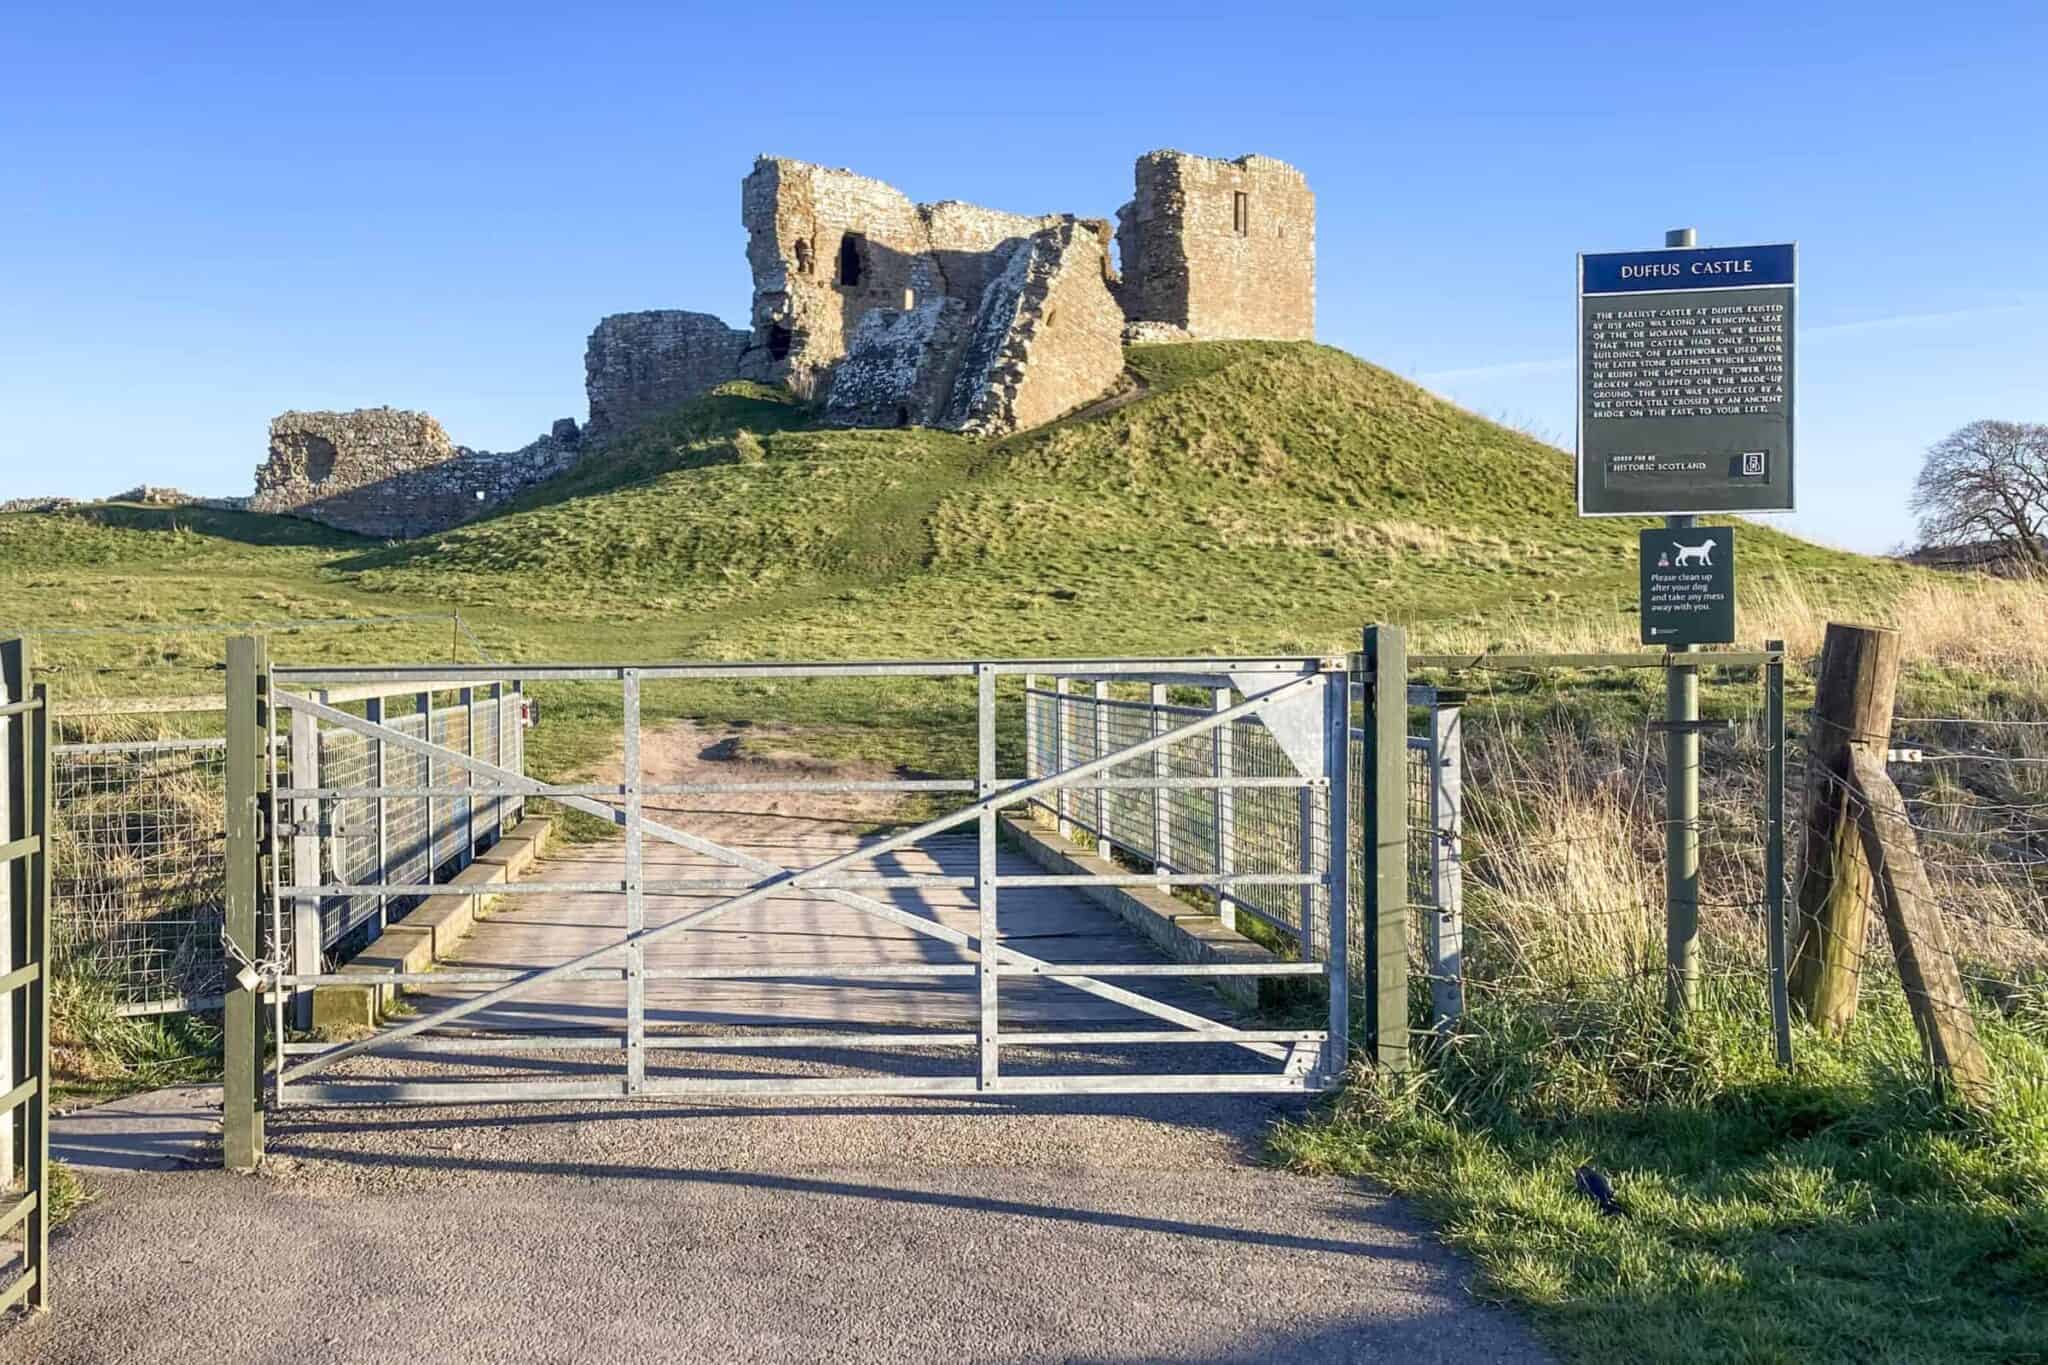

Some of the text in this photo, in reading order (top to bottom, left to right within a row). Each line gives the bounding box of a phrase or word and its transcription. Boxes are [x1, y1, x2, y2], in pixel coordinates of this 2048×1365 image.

[1621, 260, 1752, 278] DUFFUS CASTLE
[1618, 310, 1656, 318] EARLIEST
[1660, 308, 1691, 316] CASTLE
[1712, 306, 1742, 314] DUFFUS
[1747, 304, 1783, 312] EXISTED
[1712, 316, 1756, 324] PRINCIPAL
[1762, 314, 1782, 322] SEAT
[1593, 332, 1604, 340] OF
[1649, 329, 1688, 337] MORAVIA
[1749, 325, 1782, 333] BELIEVE
[1594, 341, 1617, 349] THAT
[1651, 339, 1684, 347] CASTLE
[1750, 335, 1782, 343] TIMBER
[1667, 347, 1728, 355] EARTHWORKS
[1613, 360, 1637, 368] LATER
[1671, 358, 1711, 366] DEFENCES
[1715, 356, 1744, 364] WHICH
[1749, 355, 1782, 363] SURVIVE
[1642, 369, 1659, 377] THE
[1683, 367, 1723, 375] CENTURY
[1730, 365, 1759, 373] TOWER
[1765, 364, 1782, 372] HAS
[1594, 381, 1628, 389] BROKEN
[1658, 378, 1690, 387] SLIPPED
[1696, 377, 1710, 385] ON
[1718, 376, 1734, 384] THE
[1740, 375, 1782, 383] MADE-UP
[1639, 389, 1656, 397] THE
[1662, 389, 1680, 397] SITE
[1707, 386, 1755, 395] ENCIRCLED
[1761, 385, 1771, 393] BY
[1673, 397, 1709, 406] CROSSED
[1714, 396, 1724, 404] BY
[1728, 396, 1740, 404] AN
[1745, 395, 1782, 403] ANCIENT
[1594, 410, 1624, 418] BRIDGE
[1649, 408, 1666, 416] THE
[1717, 406, 1740, 414] YOUR
[1613, 462, 1706, 472] HISTORIC SCOTLAND
[1651, 574, 1677, 582] Please
[1702, 575, 1712, 583] up
[1651, 583, 1670, 591] after
[1692, 582, 1708, 592] dog
[1688, 594, 1702, 602] any
[1651, 605, 1672, 613] away
[1673, 602, 1692, 611] with
